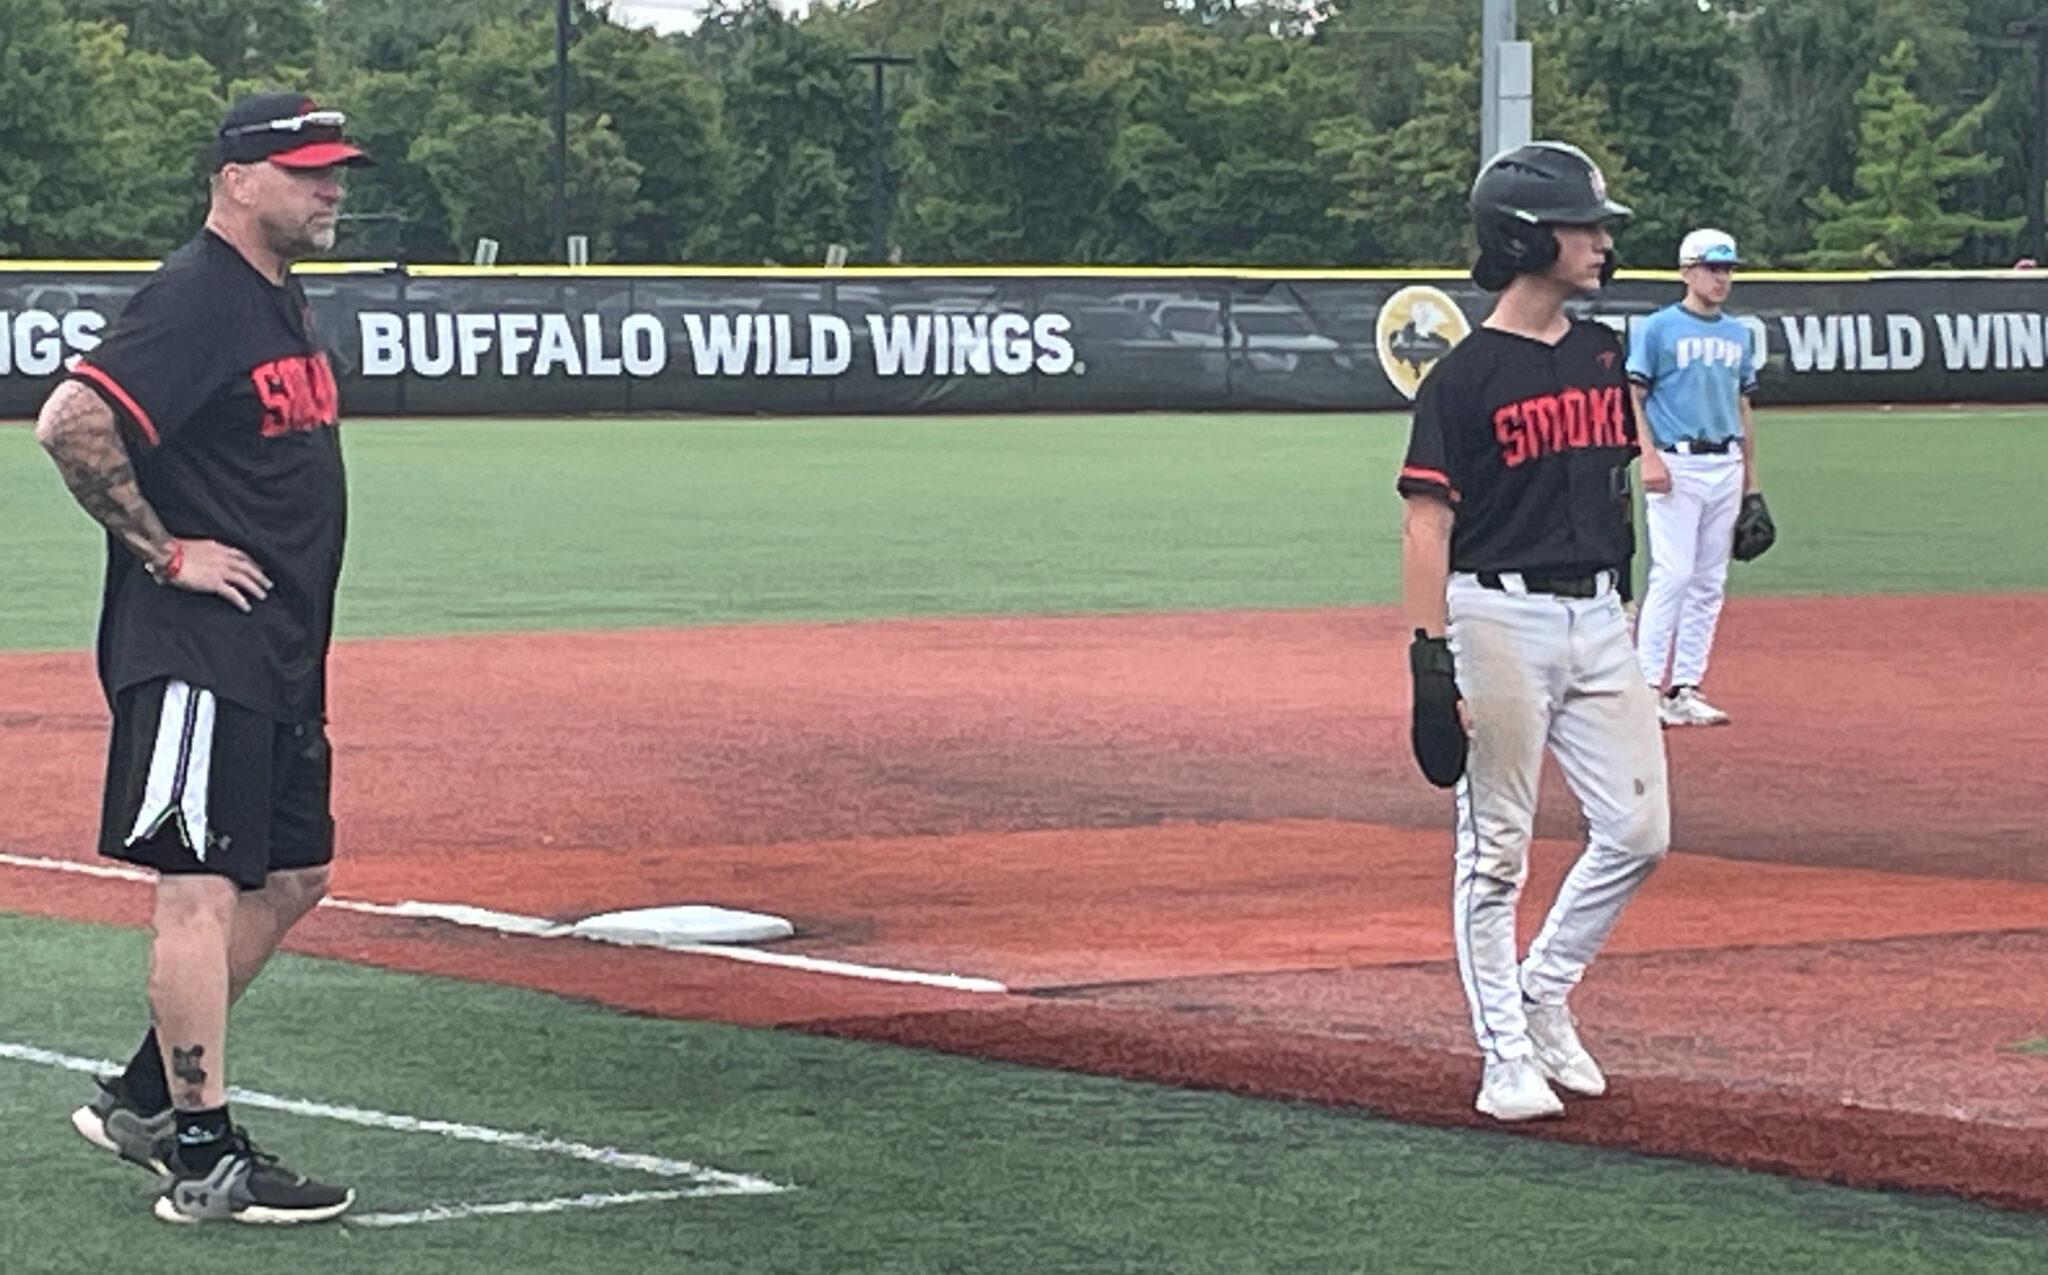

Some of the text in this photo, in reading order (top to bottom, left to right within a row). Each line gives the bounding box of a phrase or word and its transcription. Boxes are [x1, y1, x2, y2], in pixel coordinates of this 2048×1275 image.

[359, 313, 666, 376] BUFFALO
[684, 313, 852, 375] WILD
[1781, 314, 1925, 371] WILD
[1933, 313, 2048, 370] WIN
